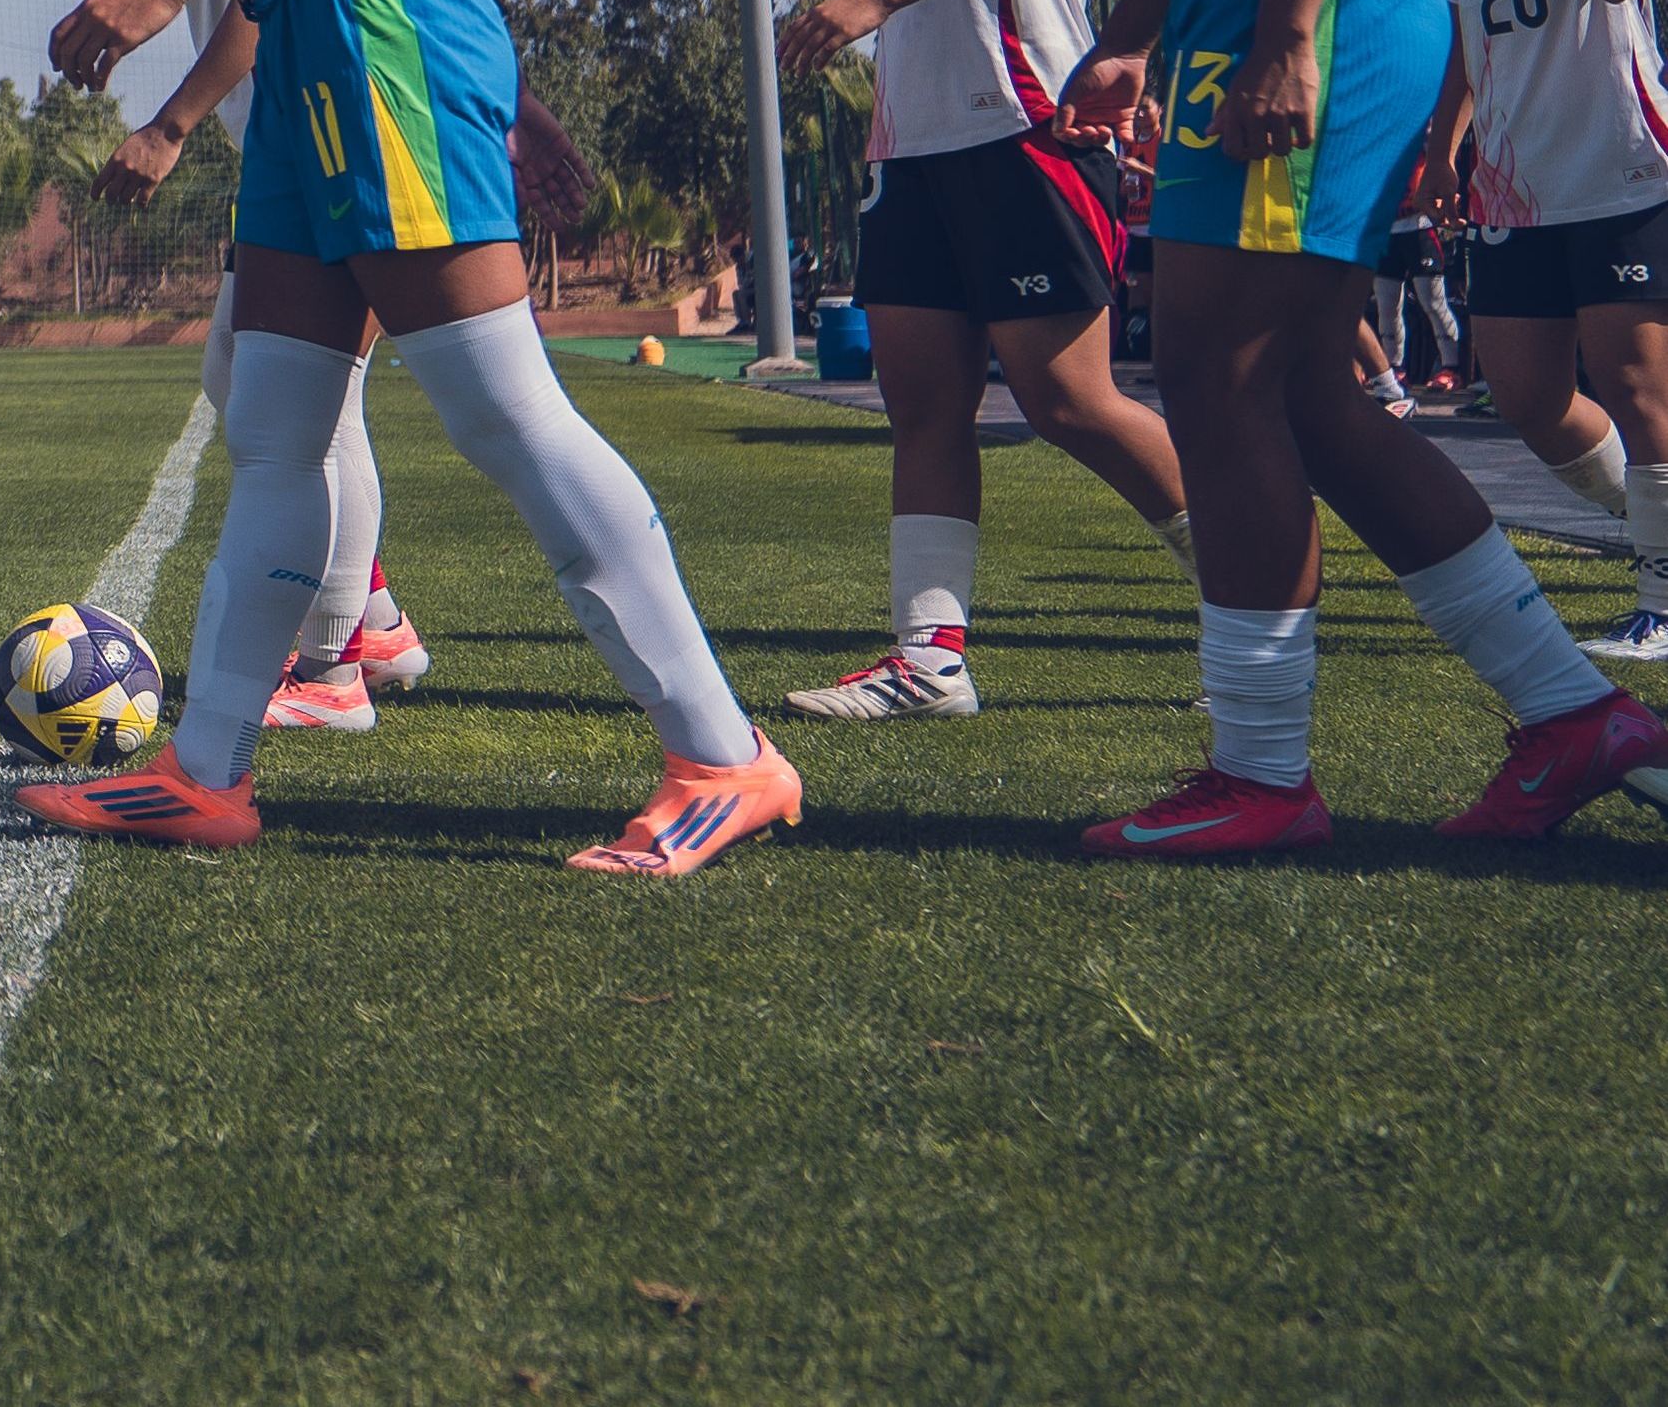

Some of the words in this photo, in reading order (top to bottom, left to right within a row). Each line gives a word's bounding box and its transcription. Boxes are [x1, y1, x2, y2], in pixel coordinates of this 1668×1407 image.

[1162, 50, 1232, 149] 13
[302, 81, 345, 178] 11
[1611, 264, 1649, 282] Y-3
[1010, 275, 1051, 296] Y-3
[267, 568, 321, 592] BRA
